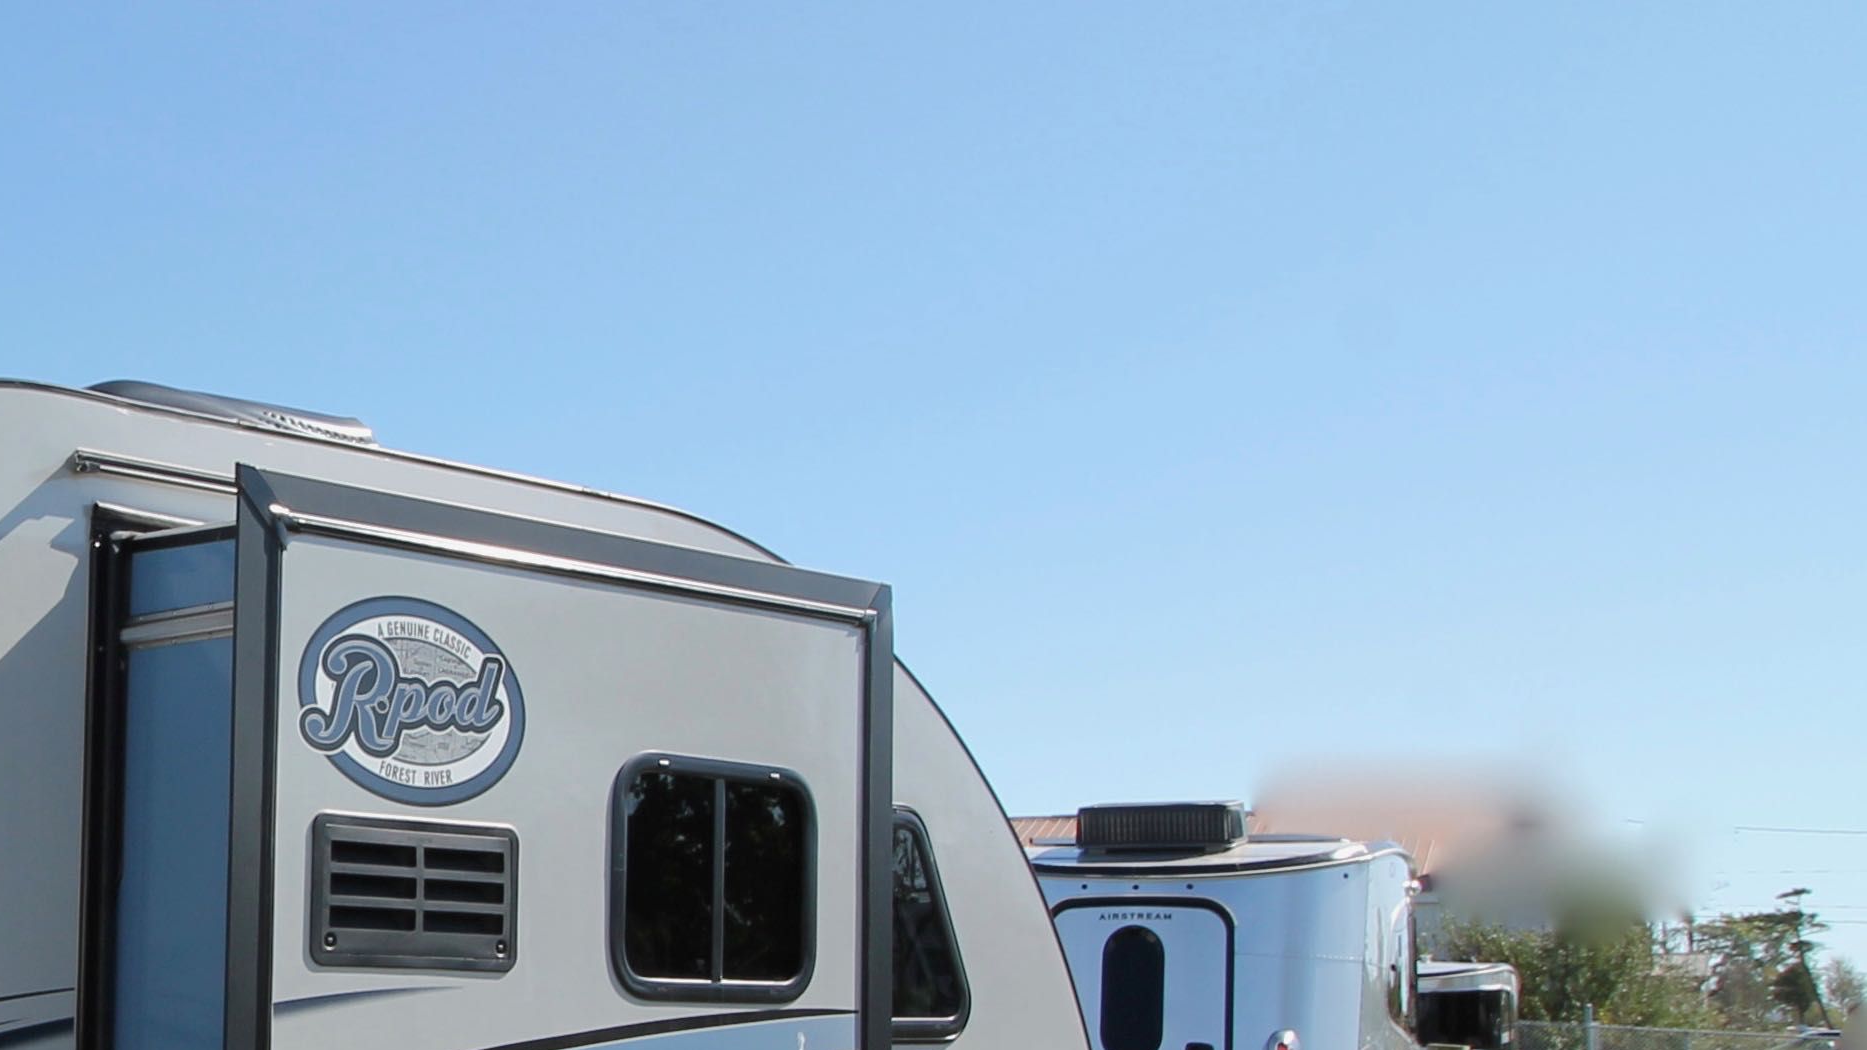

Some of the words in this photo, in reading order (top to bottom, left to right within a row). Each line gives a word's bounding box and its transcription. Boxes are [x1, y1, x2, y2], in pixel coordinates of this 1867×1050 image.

[377, 622, 385, 638] A
[386, 620, 431, 640] GENUINE
[432, 627, 473, 659] CLASSIC
[379, 760, 417, 785] FOREST
[423, 769, 453, 786] RIVER
[1098, 911, 1173, 921] AIRSTREAM
